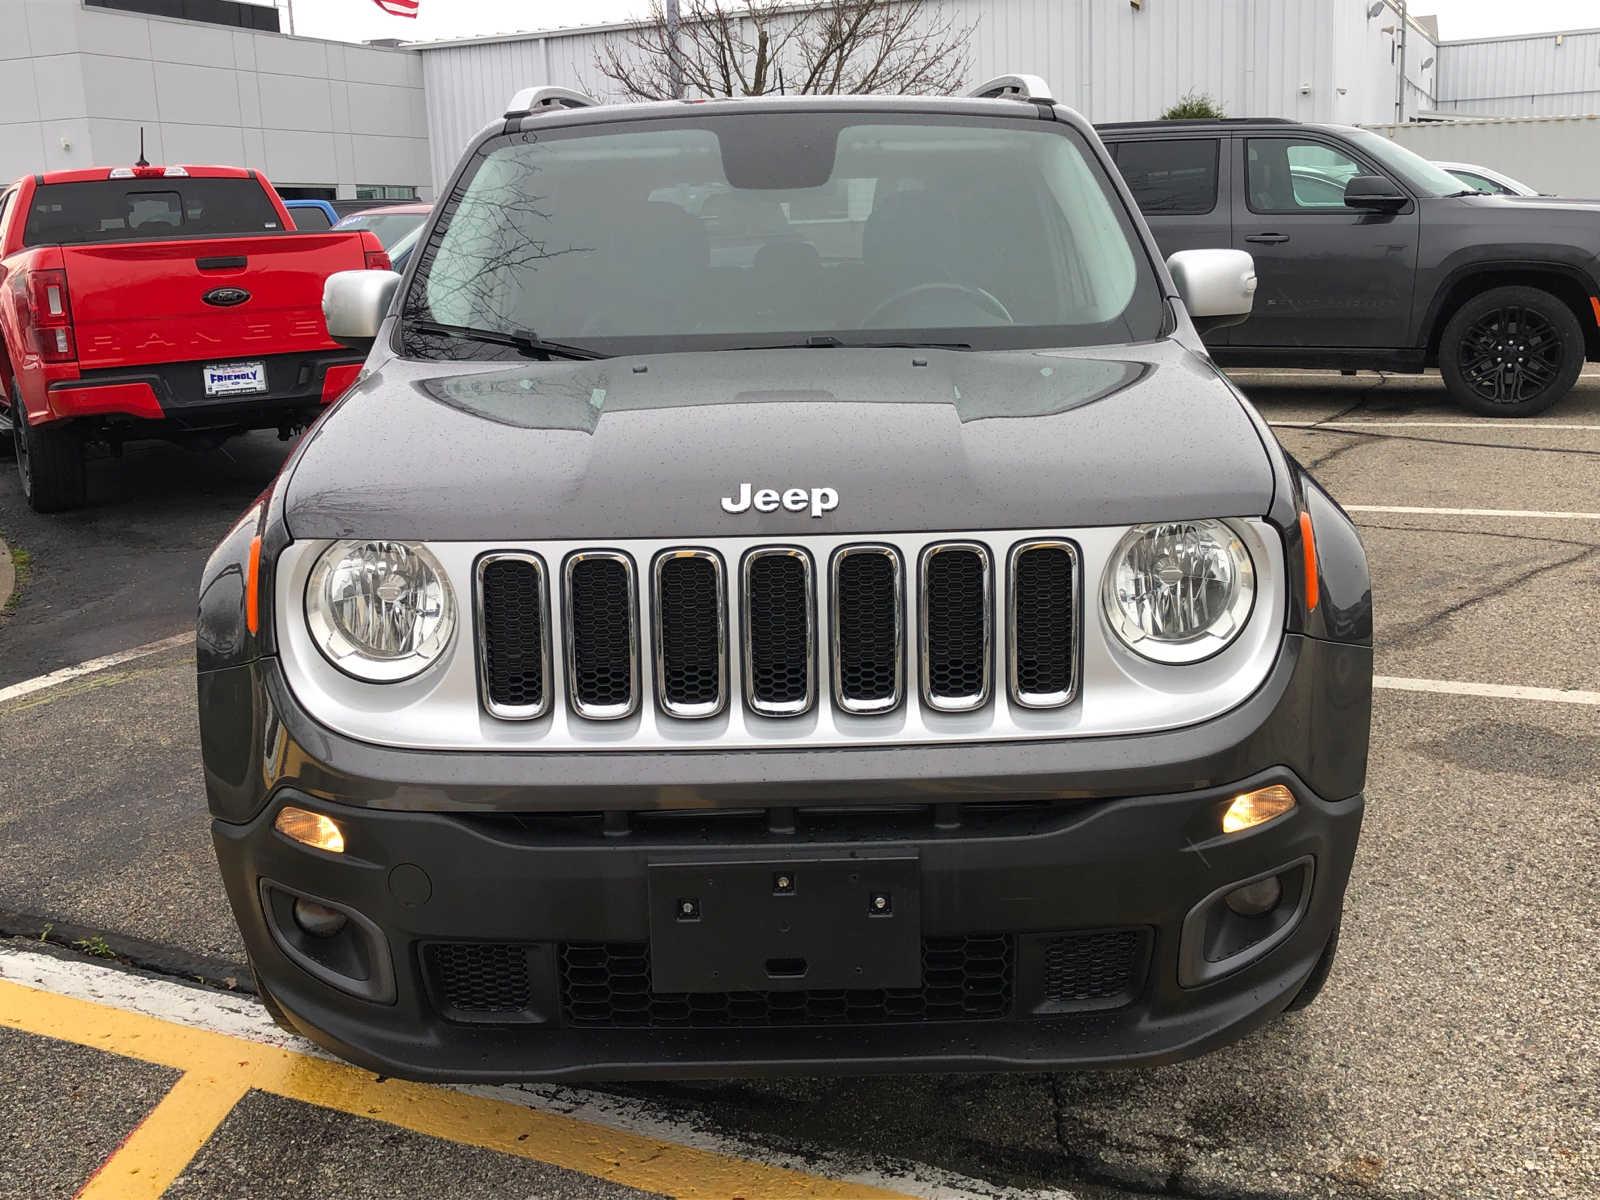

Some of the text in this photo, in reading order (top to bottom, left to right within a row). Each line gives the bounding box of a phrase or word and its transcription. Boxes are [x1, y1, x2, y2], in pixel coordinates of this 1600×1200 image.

[217, 291, 238, 301] Ford
[210, 370, 257, 384] FRIENDLY
[720, 482, 840, 519] Jeep
